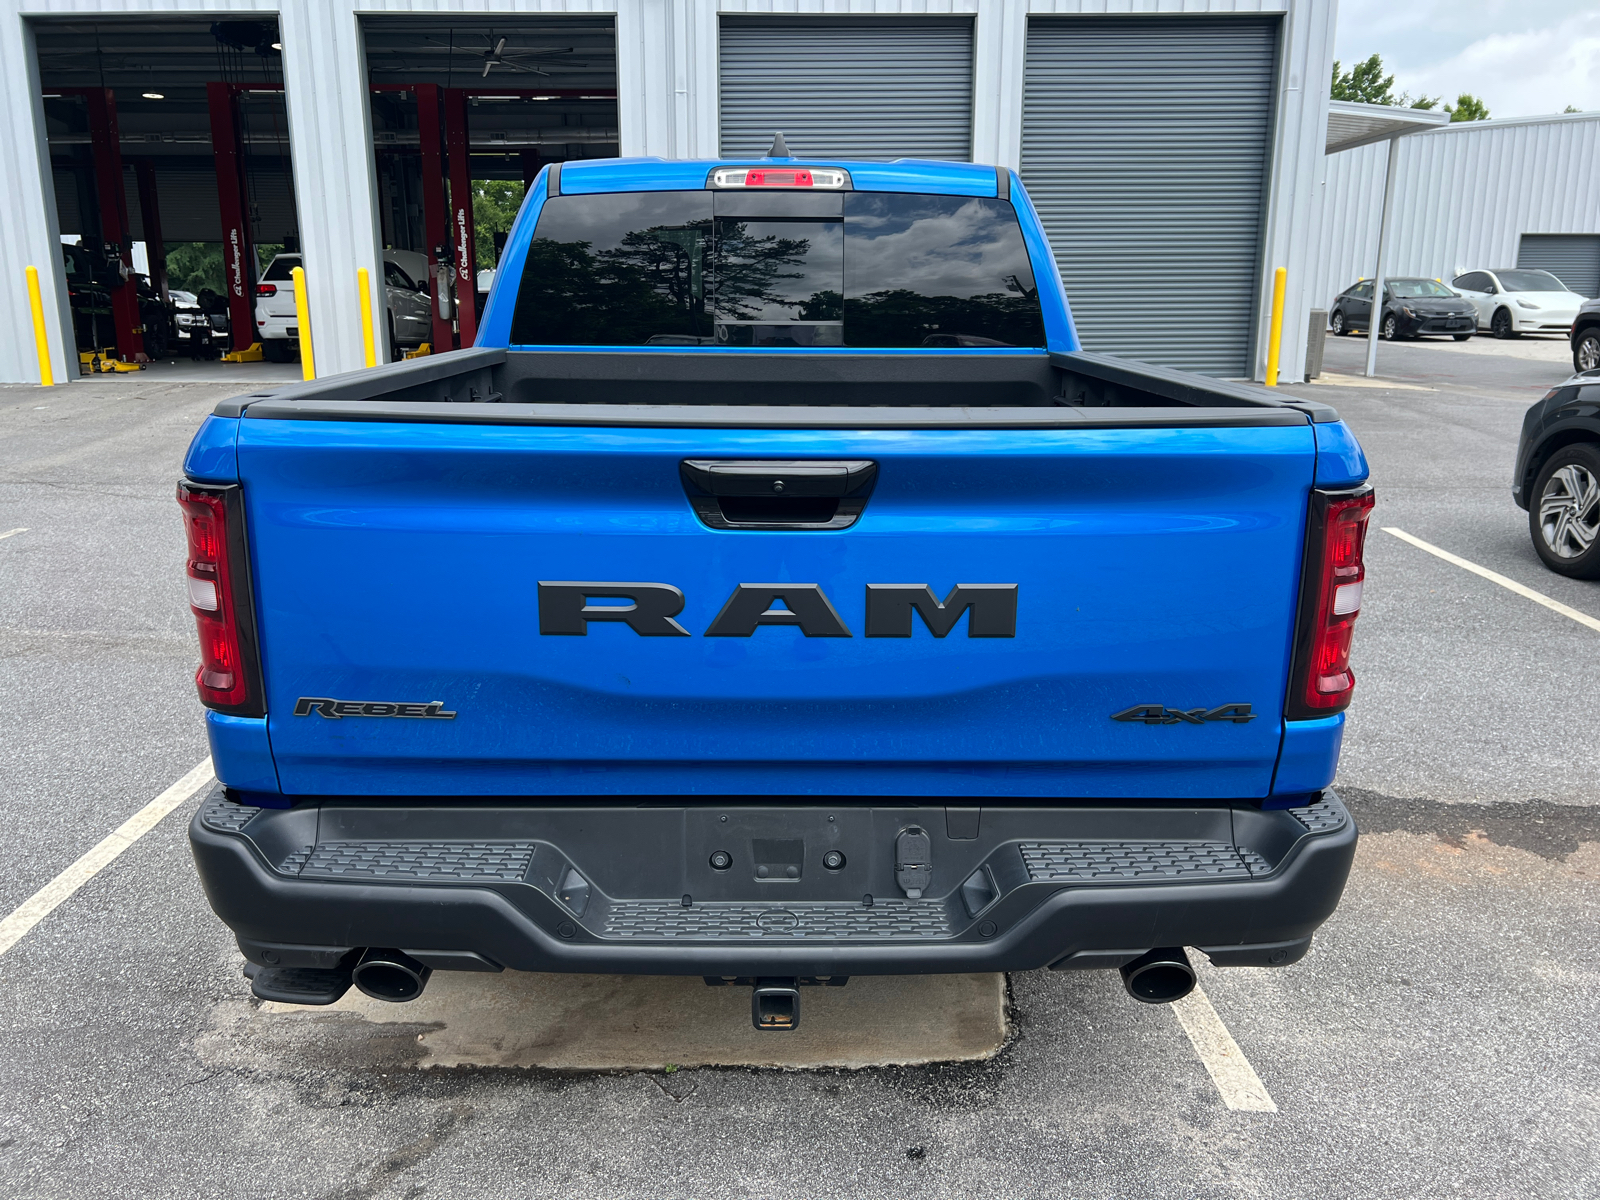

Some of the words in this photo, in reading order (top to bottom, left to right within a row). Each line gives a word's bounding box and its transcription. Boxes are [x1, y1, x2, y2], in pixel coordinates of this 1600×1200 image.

[230, 228, 238, 244] Lifts
[457, 208, 465, 225] Lifts
[231, 244, 241, 284] Challenger
[458, 225, 468, 267] Challenger
[537, 580, 1019, 638] RAM
